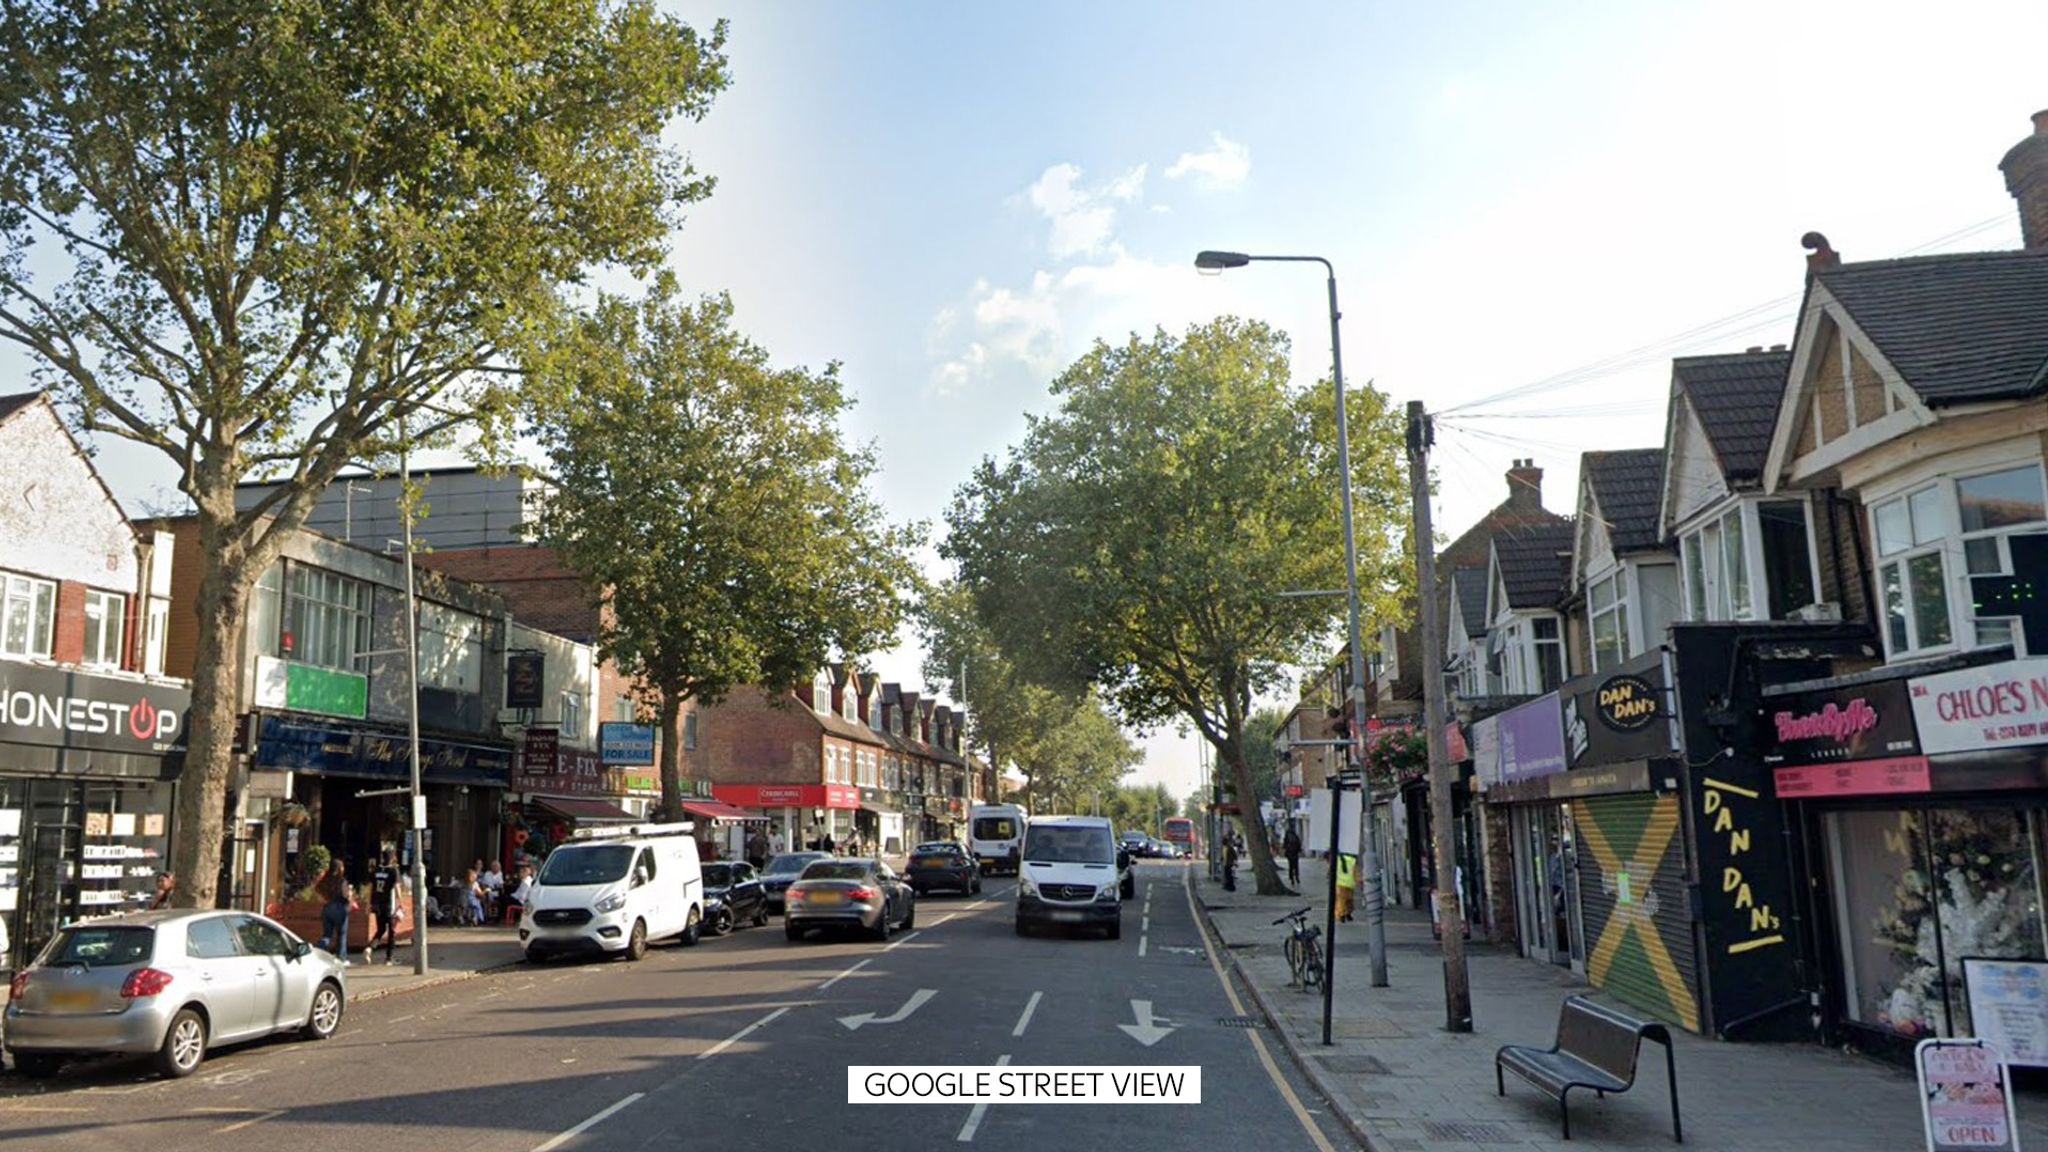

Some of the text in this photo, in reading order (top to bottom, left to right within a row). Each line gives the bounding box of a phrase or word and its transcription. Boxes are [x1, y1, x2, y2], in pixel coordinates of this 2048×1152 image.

[1600, 685, 1632, 706] DAN
[1937, 681, 2027, 722] CHLOE'S
[605, 749, 650, 760] FOR SALE
[1704, 789, 1750, 856] DAN
[1948, 1127, 1995, 1143] OPEN
